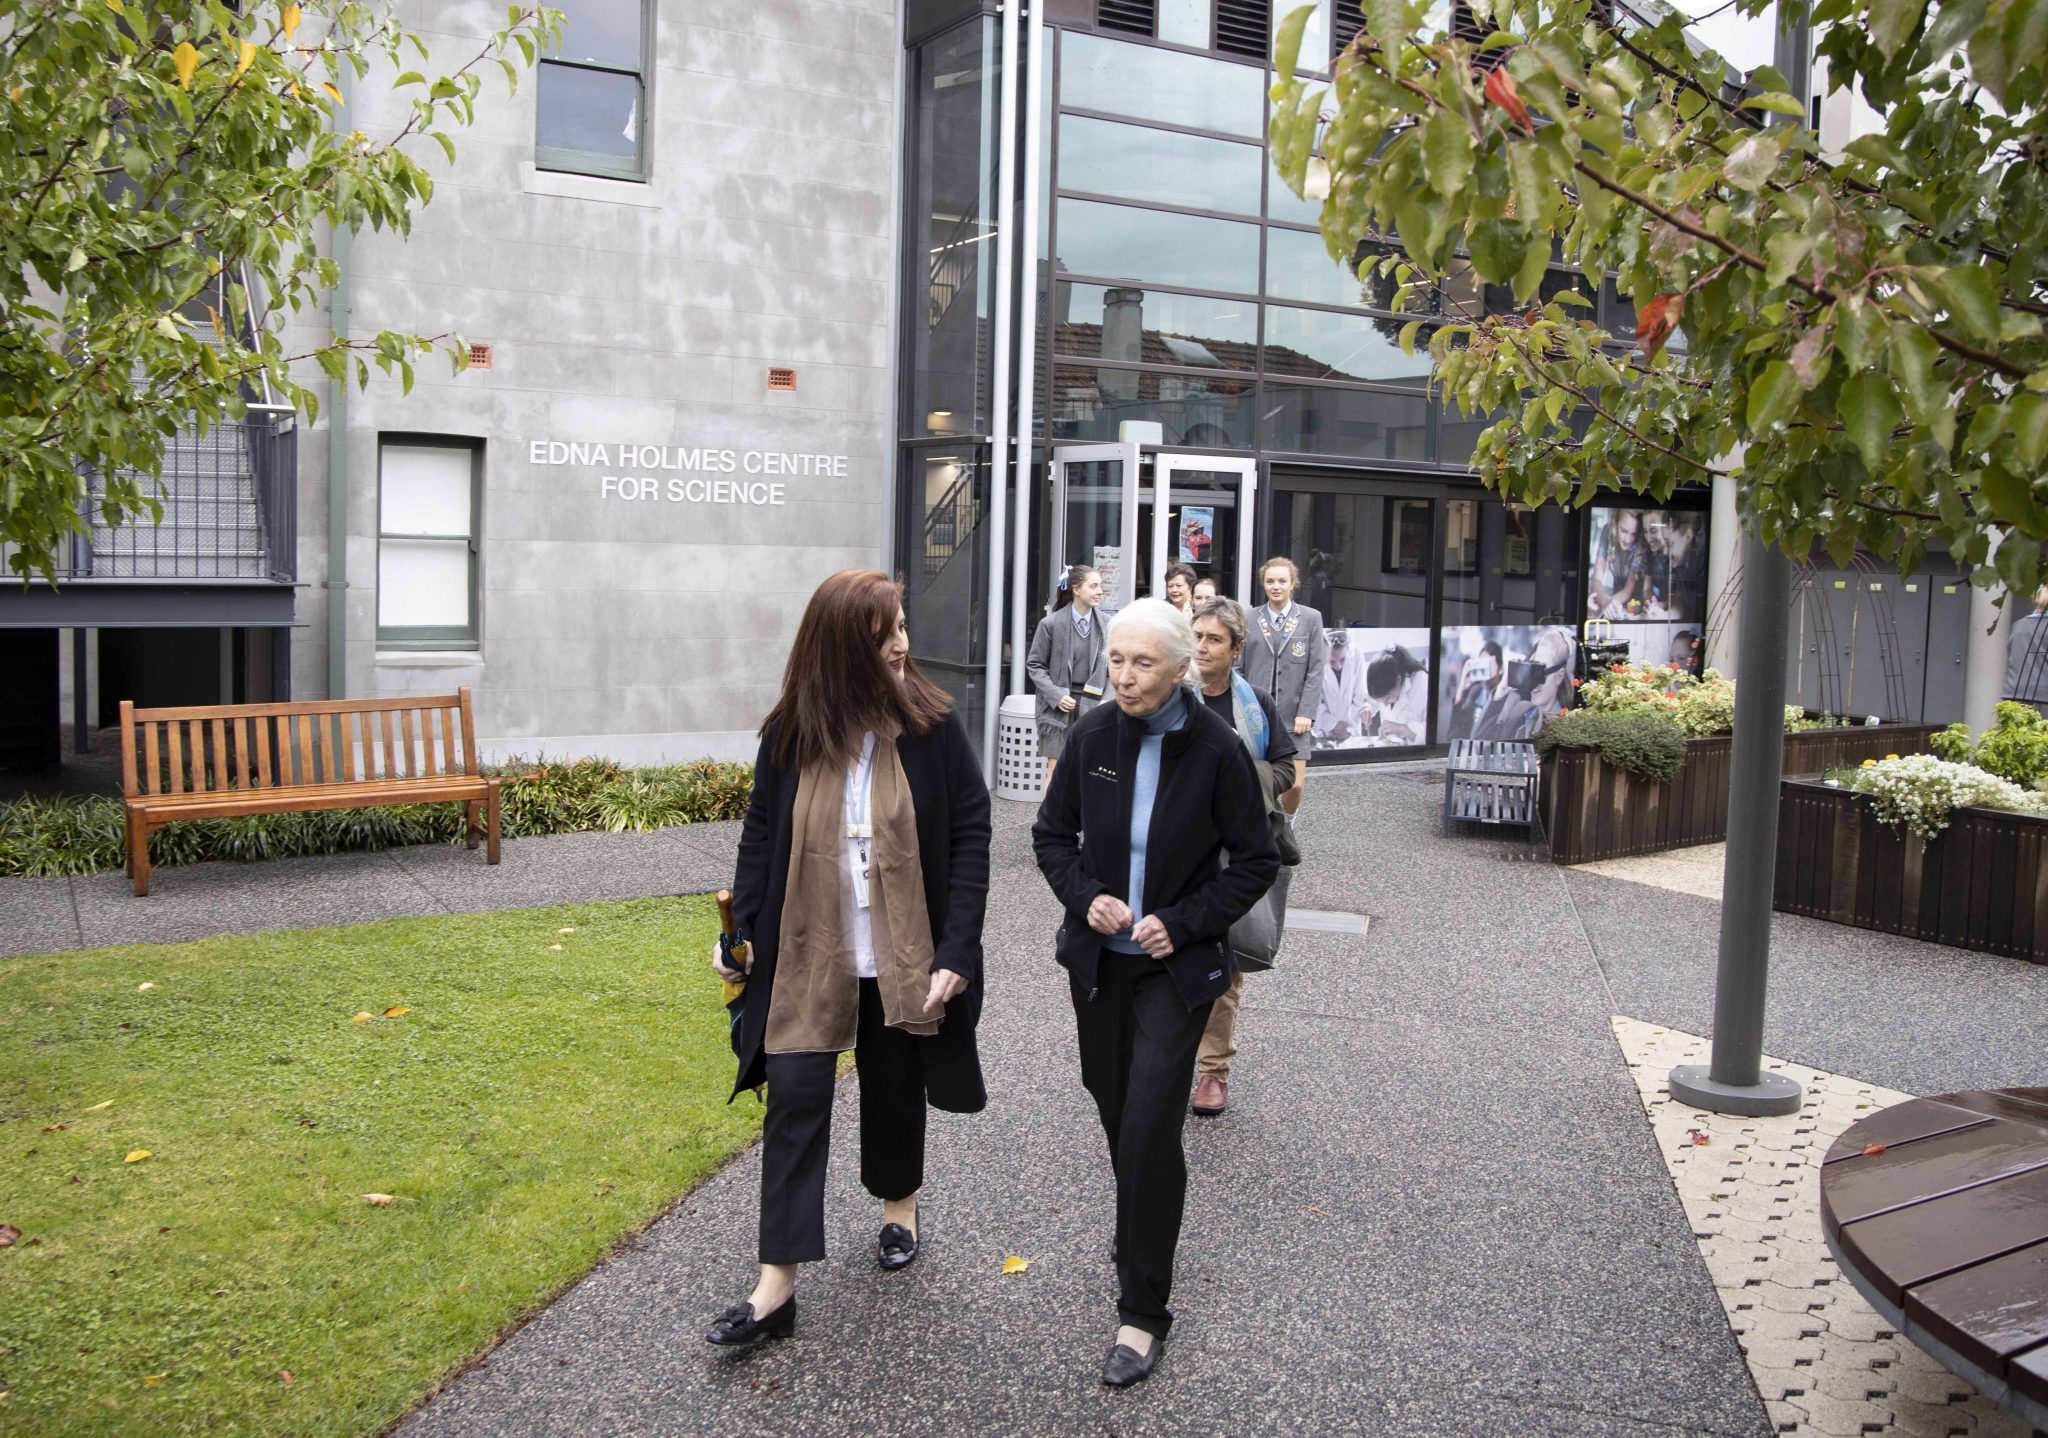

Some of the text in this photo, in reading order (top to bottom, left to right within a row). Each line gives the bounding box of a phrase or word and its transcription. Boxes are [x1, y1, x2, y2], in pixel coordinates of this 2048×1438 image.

[529, 440, 849, 477] EDNA HOLMES CENTRE
[601, 476, 786, 505] FOR SCIENCE
